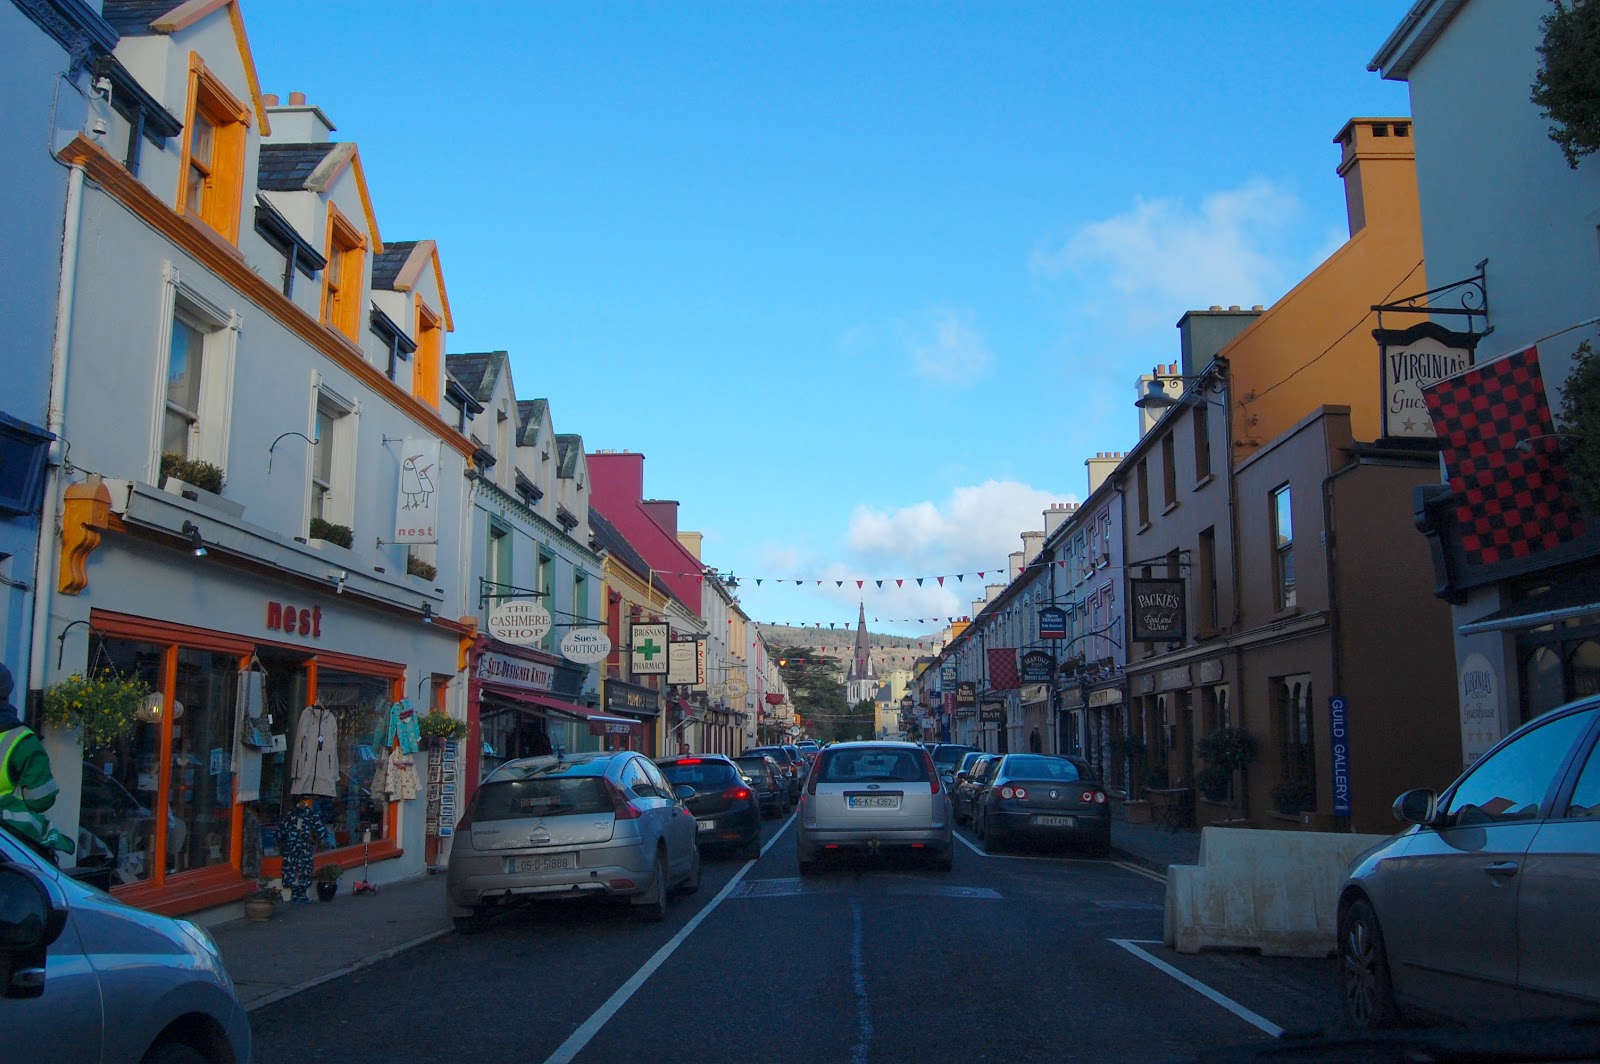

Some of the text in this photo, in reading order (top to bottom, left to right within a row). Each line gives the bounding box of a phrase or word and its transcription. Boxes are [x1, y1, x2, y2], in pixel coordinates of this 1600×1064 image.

[1390, 351, 1465, 386] VIRGINIA'S
[1391, 389, 1431, 416] Gues
[398, 527, 433, 536] nest
[1137, 593, 1180, 609] PACKIE'S
[505, 605, 533, 613] THE
[267, 601, 322, 637] nest
[491, 615, 549, 627] CASHMERE
[497, 628, 544, 639] SHOP
[634, 627, 666, 637] BROSNAN'S
[574, 634, 598, 643] Sue's
[563, 643, 609, 654] BOUTIQUE
[634, 661, 666, 670] PHARMACY
[1332, 699, 1348, 802] GUILD GALLERY
